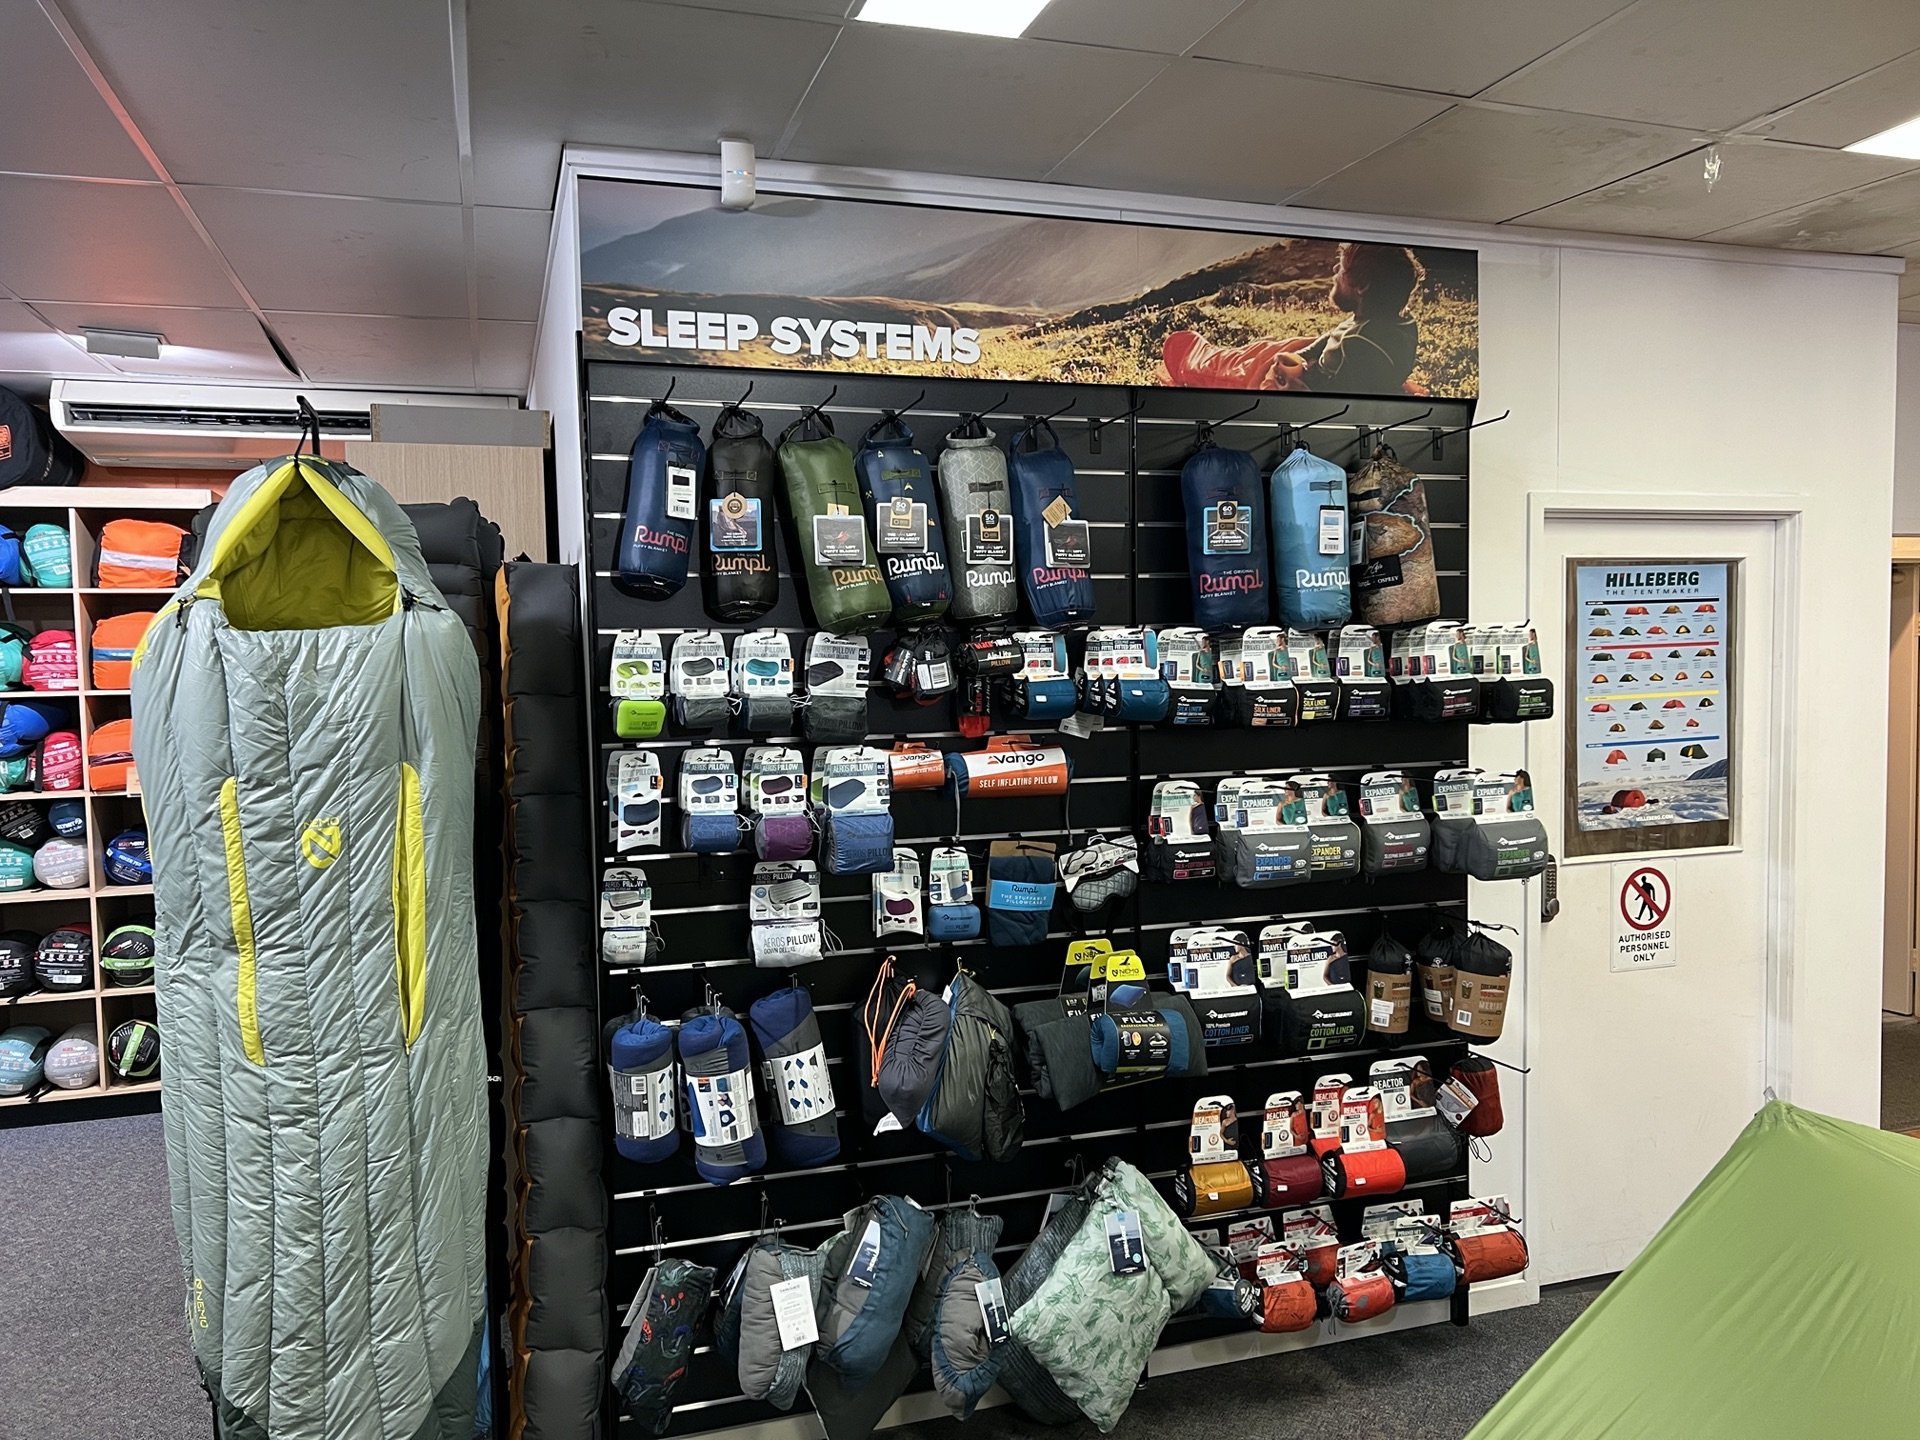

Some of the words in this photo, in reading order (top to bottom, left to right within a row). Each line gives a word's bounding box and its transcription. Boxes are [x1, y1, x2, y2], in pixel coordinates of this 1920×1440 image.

[607, 307, 759, 351] SLEEP
[770, 316, 982, 364] SYSTEMS
[985, 513, 995, 521] 50
[634, 525, 688, 554] Rumpl
[712, 553, 770, 575] Rumpl
[887, 552, 944, 574] Rumpl
[966, 566, 1016, 588] Rumpl
[1032, 567, 1088, 585] Rumpl
[1200, 568, 1263, 594] Rumpl
[1296, 566, 1350, 590] Rumpl
[1377, 576, 1399, 584] OSPREY
[1605, 571, 1699, 588] HILLEBERG
[993, 753, 1045, 766] Vango
[833, 764, 850, 773] AEROS
[850, 763, 873, 772] PILLOW
[979, 778, 996, 789] SELF
[997, 776, 1032, 787] INFLATING
[1033, 775, 1058, 785] PILLOW
[1365, 787, 1395, 797] EXPANDER
[1438, 784, 1469, 793] EXPANDER
[1477, 787, 1505, 796] EXPANDER
[1242, 799, 1273, 808] EXPANDER
[1256, 856, 1291, 866] EXPANDER
[772, 872, 793, 880] PILLOW
[1011, 884, 1039, 894] Rumpl
[763, 936, 786, 948] AEROS
[786, 933, 816, 946] PILLOW
[1618, 930, 1671, 943] AUTHORISED
[1262, 944, 1283, 952] TRAVEL
[1620, 941, 1669, 953] PERSONNEL
[1189, 953, 1212, 962] TRAVEL
[1213, 951, 1231, 960] LINER
[1290, 954, 1311, 962] TRAVEL
[1311, 951, 1328, 960] LINER
[1633, 952, 1656, 962] ONLY
[1121, 1016, 1156, 1024] FILLO
[1204, 1027, 1231, 1037] COTTON
[1231, 1025, 1249, 1034] LINER
[1310, 1027, 1335, 1037] COTTON
[1336, 1025, 1354, 1034] LINER
[1373, 1077, 1404, 1089] REACTOR
[1315, 1091, 1338, 1100] REACTOR
[1266, 1110, 1289, 1120] REACTOR
[1343, 1105, 1367, 1114] REACTOR
[1195, 1115, 1219, 1124] REACTOR
[195, 1290, 209, 1329] NEMO
